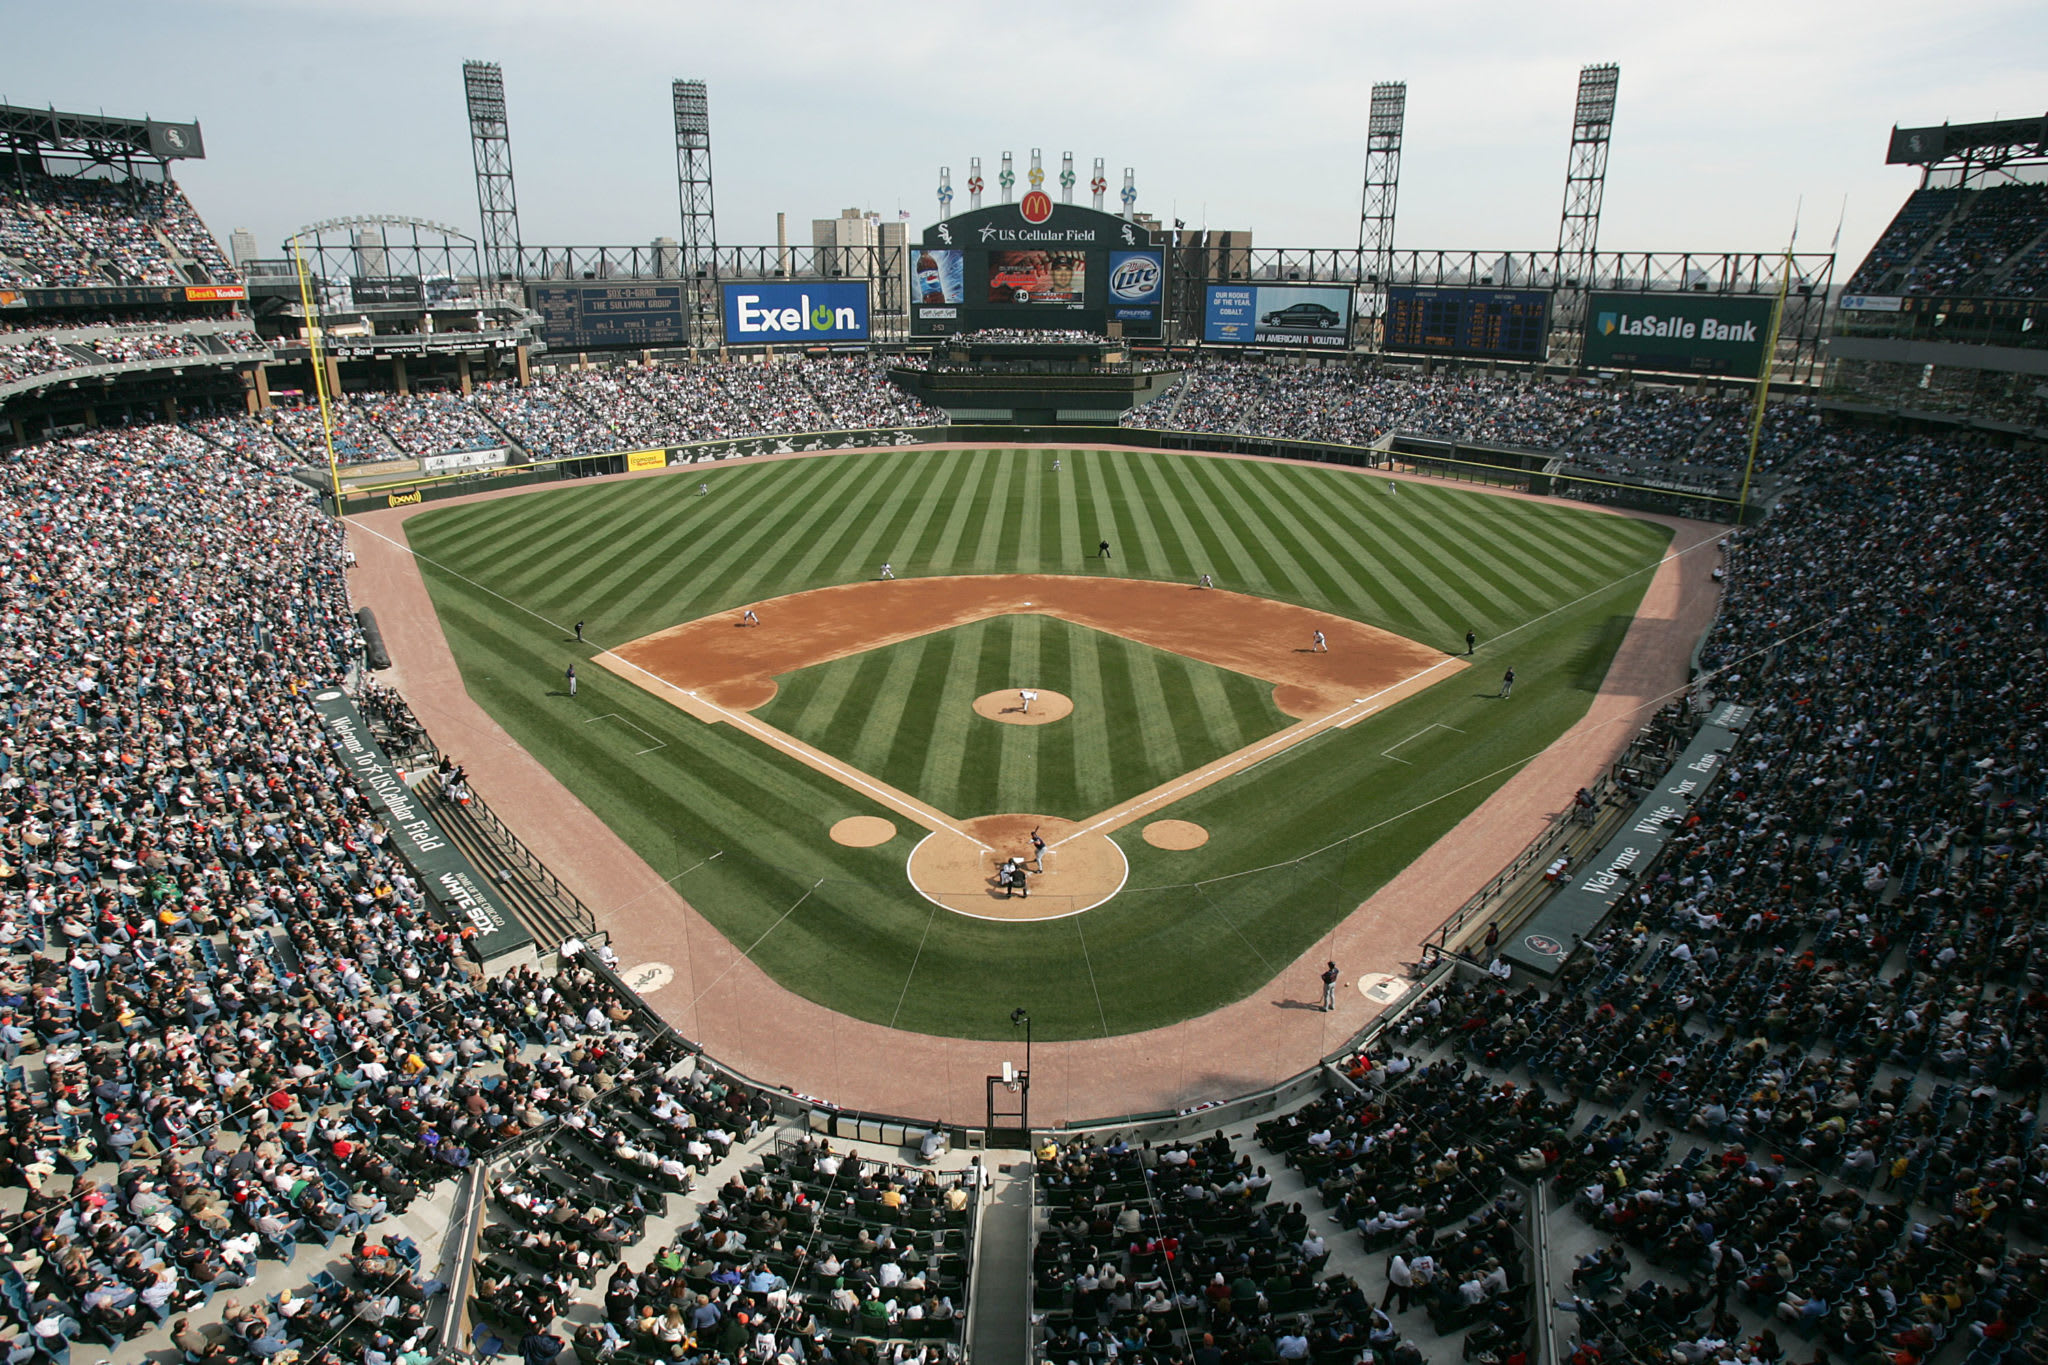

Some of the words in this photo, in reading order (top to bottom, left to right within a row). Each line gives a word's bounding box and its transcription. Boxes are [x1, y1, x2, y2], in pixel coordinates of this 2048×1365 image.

[1018, 229, 1064, 241] Cellular
[1066, 230, 1096, 241] Field
[1116, 268, 1157, 290] Lite
[216, 289, 244, 298] Kosher
[593, 301, 607, 310] THE
[610, 300, 646, 310] SULLIVAN
[648, 299, 672, 308] GROUP
[1619, 314, 1695, 339] LaSalle
[1701, 318, 1757, 342] Bank
[1255, 334, 1266, 343] AN
[1266, 334, 1302, 344] AMERICAN
[337, 348, 351, 356] Go
[353, 347, 374, 356] Sox!
[1675, 483, 1702, 494] SPORTS
[1688, 753, 1717, 773] Fans
[330, 715, 365, 754] Welcome
[354, 751, 377, 766] To
[378, 786, 416, 821] Cellular
[402, 820, 446, 853] Field
[1668, 779, 1697, 794] Sox
[1633, 805, 1675, 834] White
[1581, 846, 1641, 894] Welcome
[439, 871, 477, 910] WHITE
[466, 907, 499, 937] SOX
[455, 872, 473, 888] HOME
[472, 892, 487, 905] THE
[480, 902, 506, 927] CHICAGO
